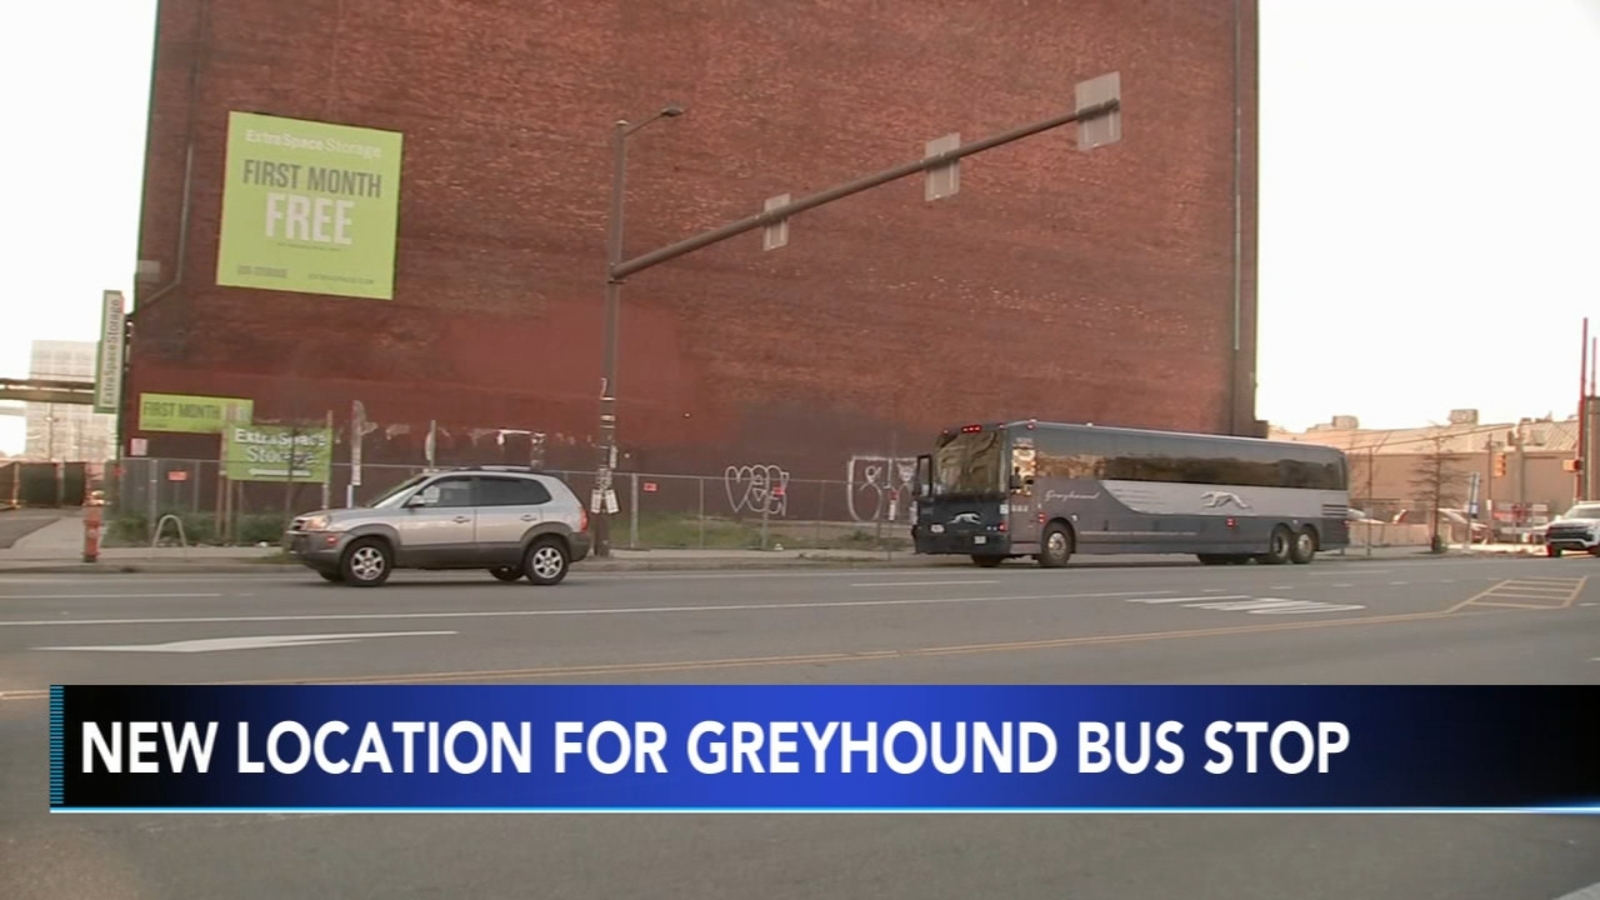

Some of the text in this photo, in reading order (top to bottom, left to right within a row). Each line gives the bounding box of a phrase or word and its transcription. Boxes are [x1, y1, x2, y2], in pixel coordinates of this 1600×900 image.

[243, 159, 382, 198] FIRST MONTH
[265, 192, 355, 245] FREE
[143, 401, 175, 417] FIRST
[179, 403, 220, 420] MONTH
